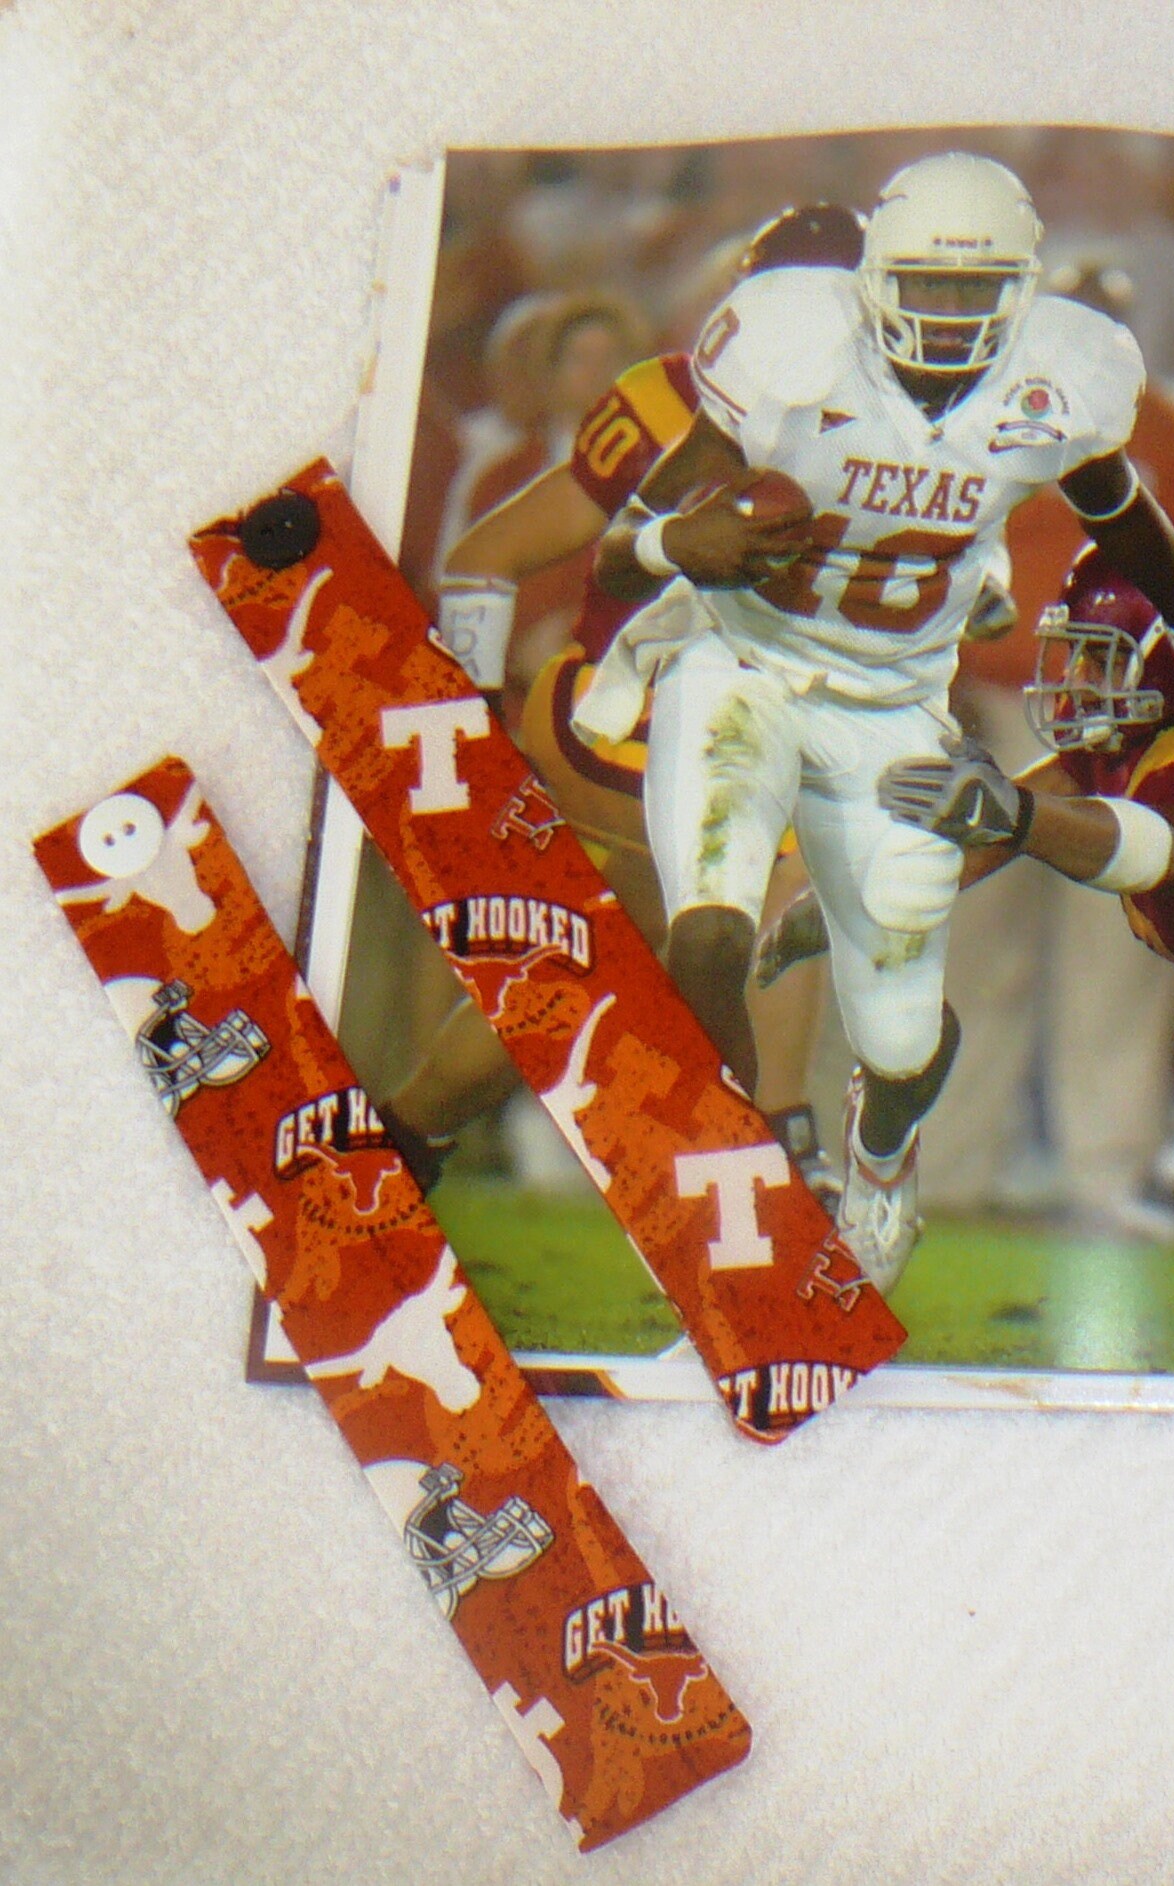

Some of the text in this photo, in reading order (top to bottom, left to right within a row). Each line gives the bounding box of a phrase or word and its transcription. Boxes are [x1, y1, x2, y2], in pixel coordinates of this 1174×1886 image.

[838, 457, 986, 524] TEXAS
[381, 695, 492, 816] T
[467, 896, 591, 969] HOOKED
[275, 1093, 339, 1172] GET
[674, 1142, 792, 1271] T
[565, 1588, 631, 1673] GET
